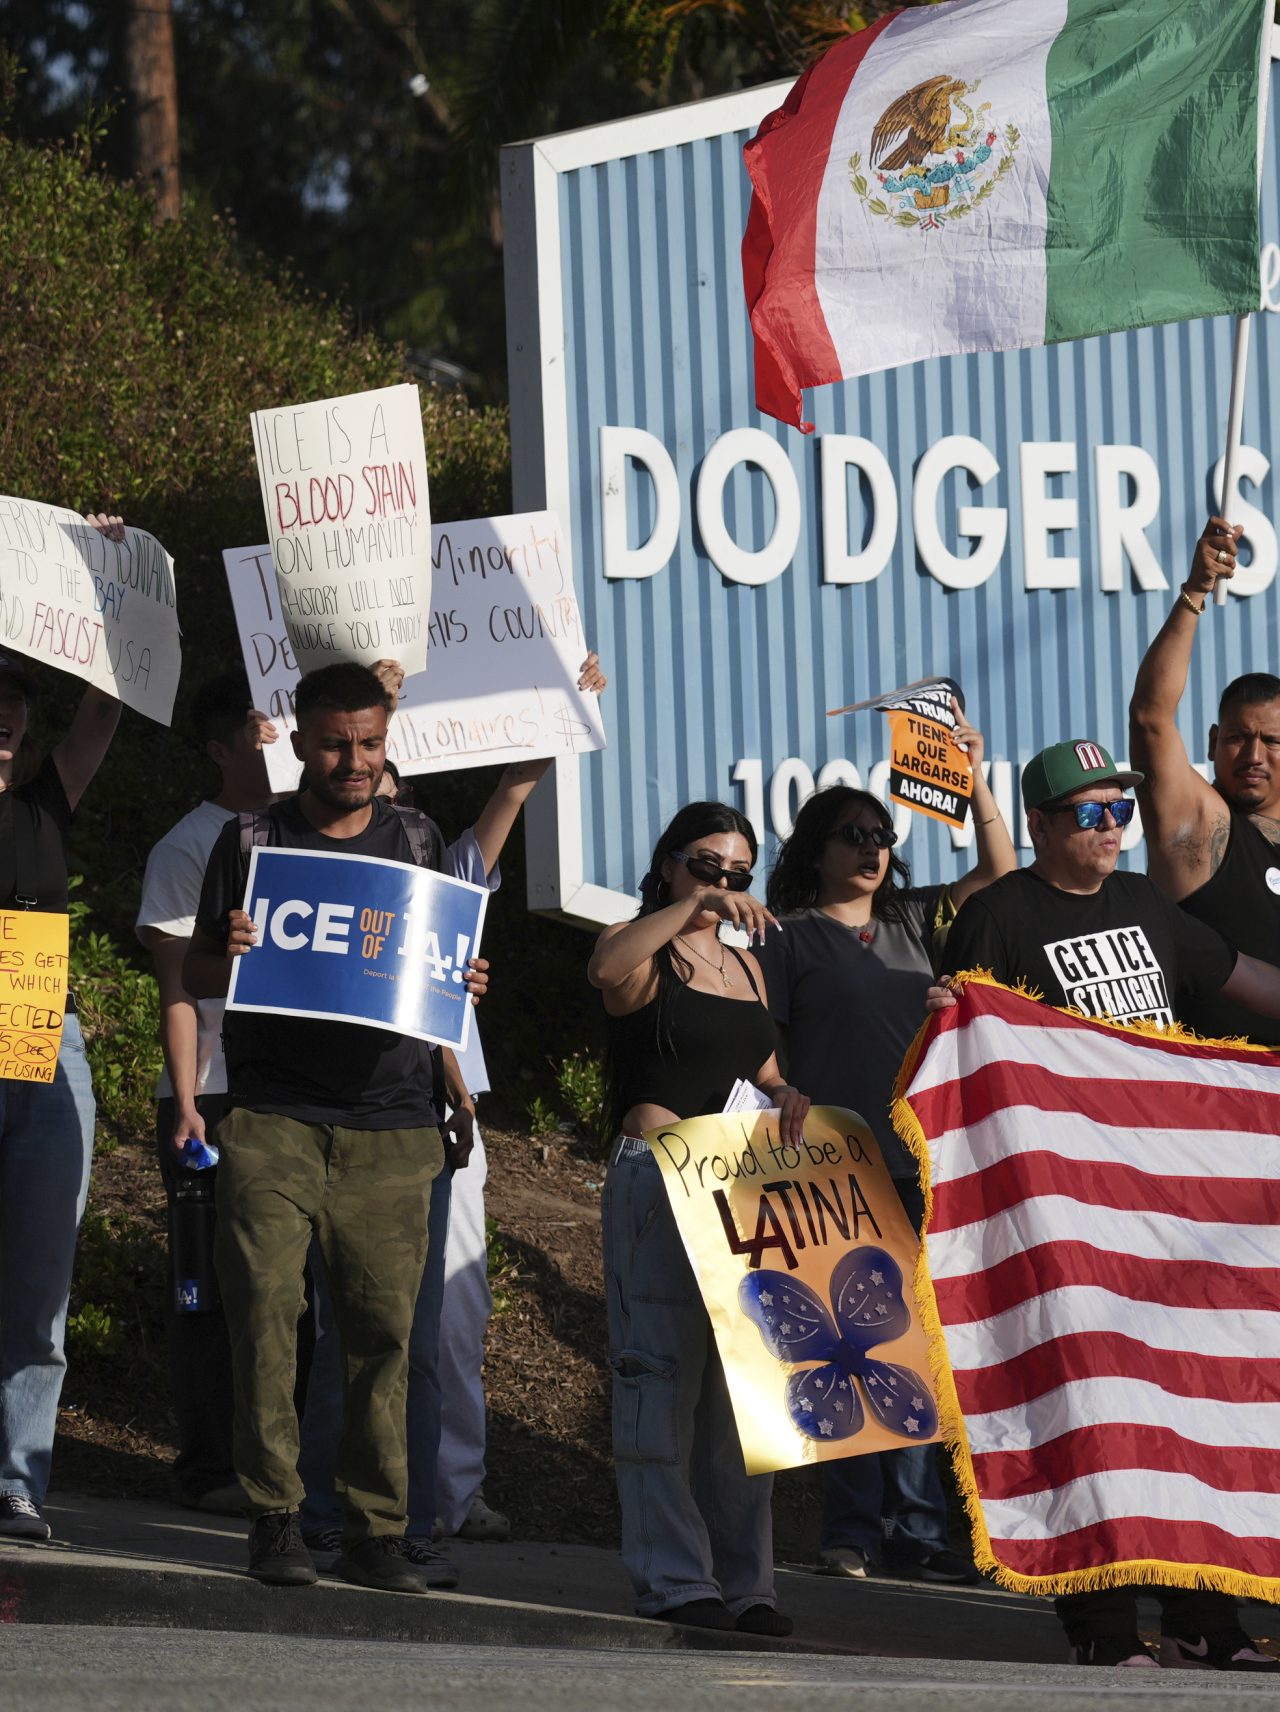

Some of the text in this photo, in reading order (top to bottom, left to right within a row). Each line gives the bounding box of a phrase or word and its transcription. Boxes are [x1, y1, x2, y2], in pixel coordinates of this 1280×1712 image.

[264, 404, 389, 475] ICE IS A
[275, 460, 417, 534] BLOOD STAIN
[600, 426, 1170, 591] DODGER
[62, 513, 99, 572] THE
[277, 534, 314, 574] ON
[8, 548, 38, 585] TO
[57, 563, 81, 603] THE
[284, 585, 339, 616] HISTORY
[348, 579, 384, 612] WILL
[389, 576, 414, 606] NOT
[28, 602, 104, 667] FASCIST
[106, 630, 151, 691] USA
[291, 613, 422, 651] JUDGE YOU KINDLY
[907, 718, 949, 746] TIENE
[916, 740, 947, 764] QUE
[894, 749, 969, 791] LARGARSE
[900, 779, 958, 815] AHORA!
[251, 897, 355, 955] ICE
[359, 907, 397, 937] OUT
[35, 952, 69, 969] GET
[362, 934, 386, 960] OF
[1054, 930, 1154, 983] GET ICE
[10, 973, 61, 993] WHICH
[363, 968, 388, 979] Deport
[0, 1003, 63, 1030] ECTED
[1073, 973, 1166, 1019] STRAIGHT
[657, 1122, 873, 1198] Proud to be a
[712, 1173, 883, 1271] LATINA
